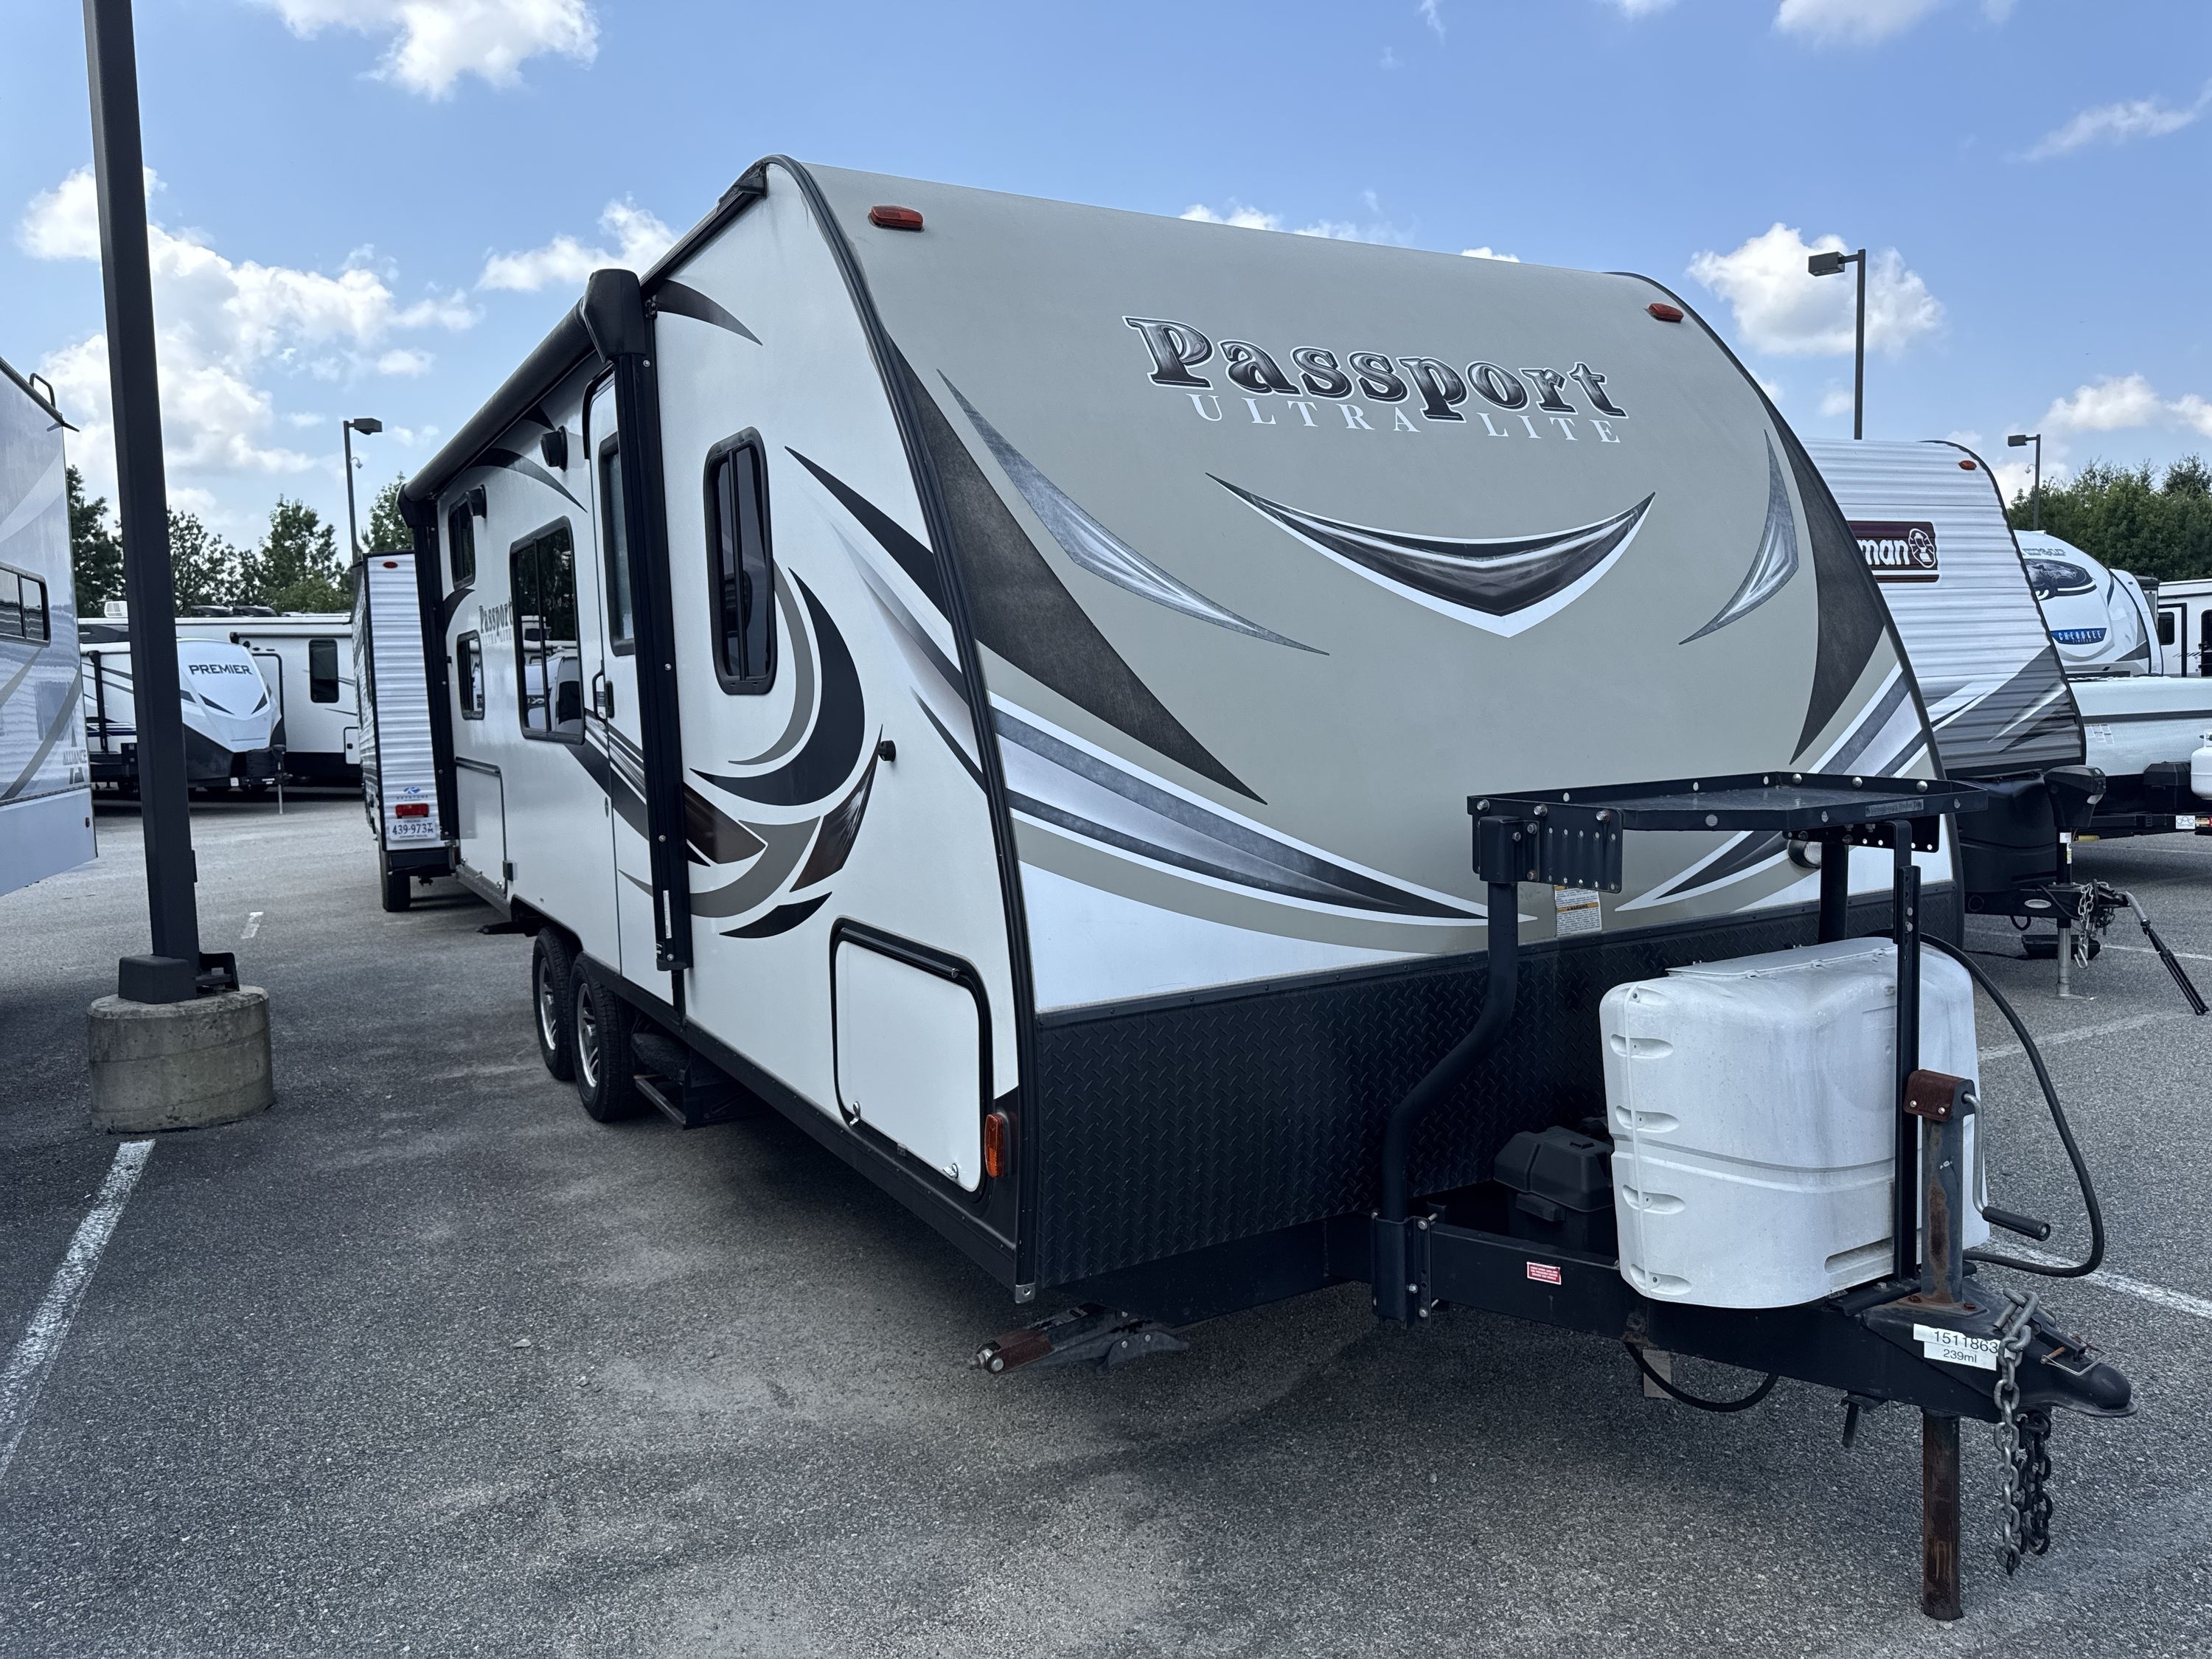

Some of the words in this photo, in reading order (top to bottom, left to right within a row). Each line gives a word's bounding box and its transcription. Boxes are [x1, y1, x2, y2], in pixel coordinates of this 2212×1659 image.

[1122, 316, 1629, 422] Passport
[1186, 393, 1422, 433] ULTRA
[1476, 412, 1621, 442] LITE
[479, 596, 513, 636] Passport
[2058, 630, 2101, 641] CHEROKEE
[188, 664, 253, 675] PREMIER
[1934, 1330, 1999, 1354] 1511863
[1943, 1349, 1978, 1363] 239ml
